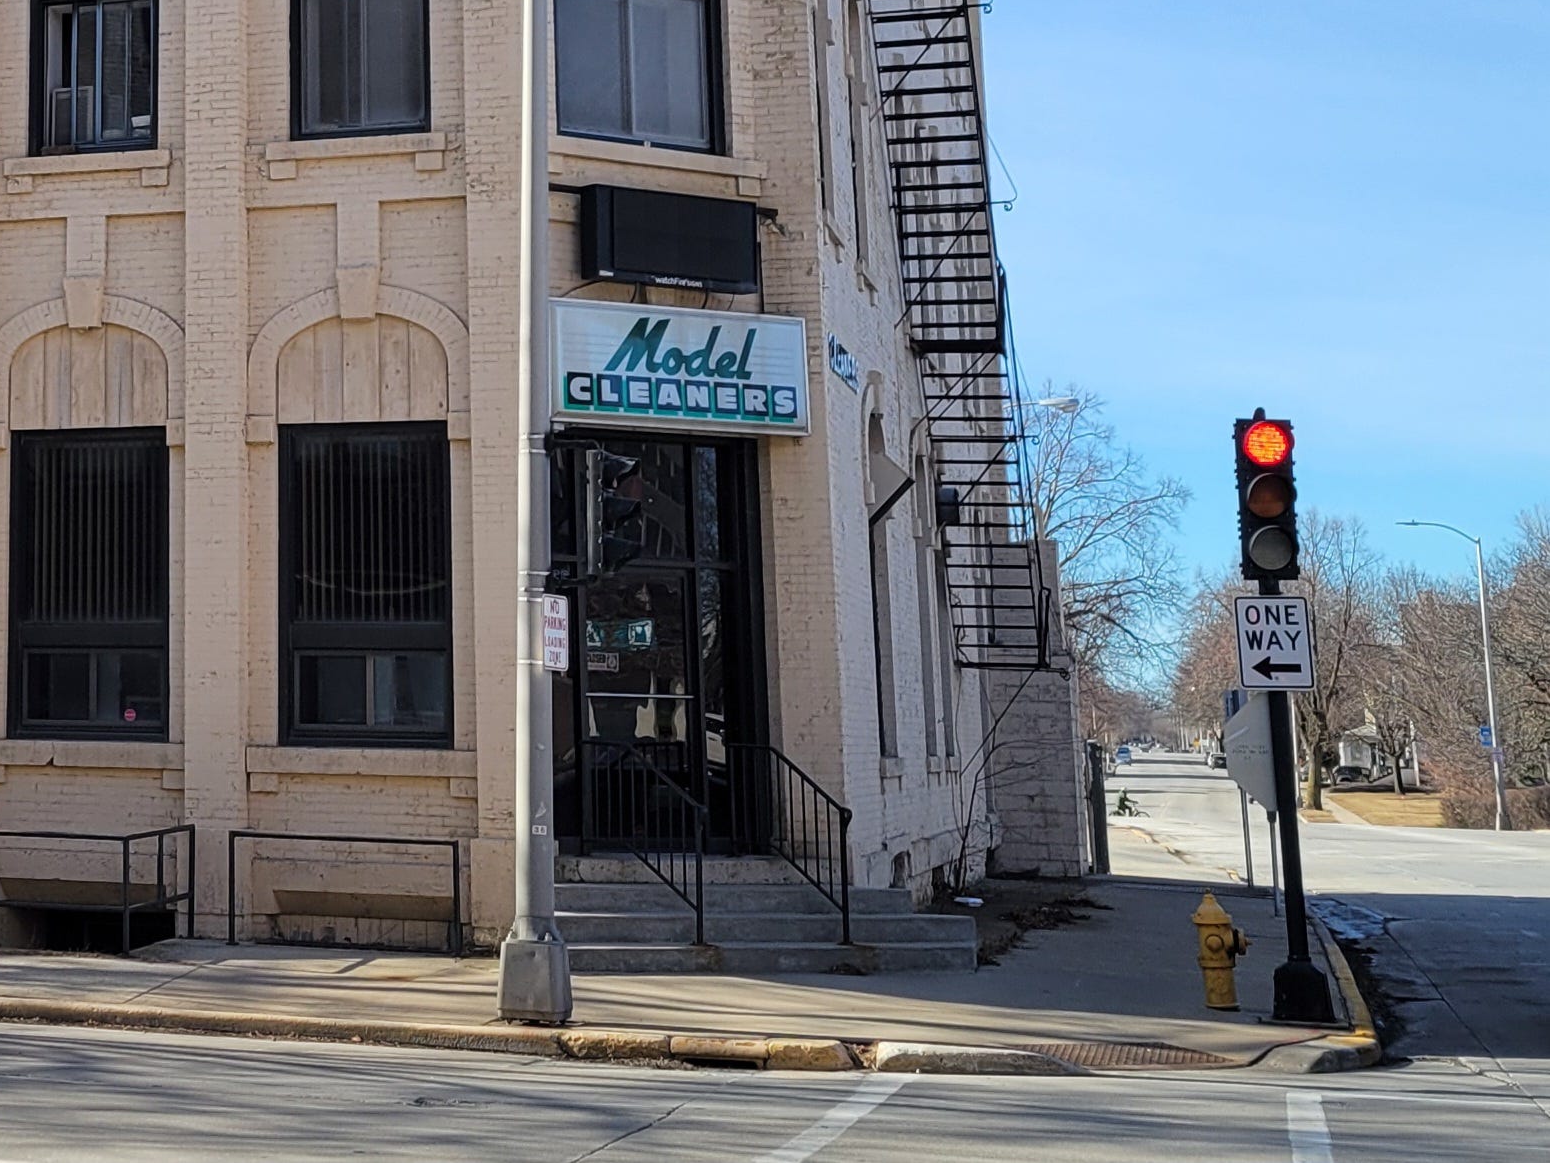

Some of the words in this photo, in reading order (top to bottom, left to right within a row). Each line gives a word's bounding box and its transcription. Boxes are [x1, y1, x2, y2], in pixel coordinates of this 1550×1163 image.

[604, 316, 757, 380] Model
[568, 376, 796, 416] CLEANERS
[550, 600, 560, 614] NO
[1245, 605, 1299, 625] ONE
[544, 615, 566, 631] PARKING
[544, 636, 566, 649] LOADING
[1245, 630, 1301, 651] WAY
[549, 650, 562, 663] ZONE
